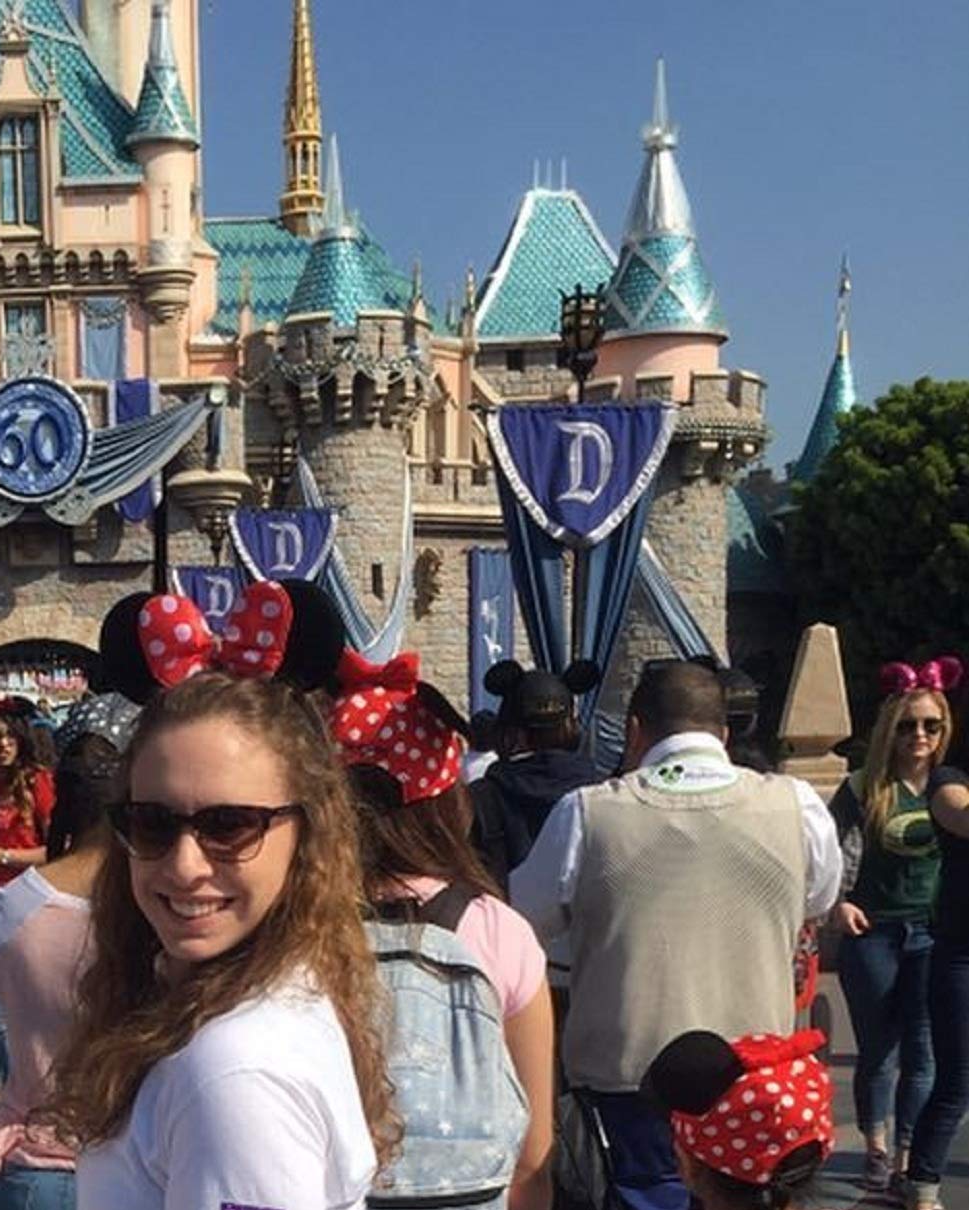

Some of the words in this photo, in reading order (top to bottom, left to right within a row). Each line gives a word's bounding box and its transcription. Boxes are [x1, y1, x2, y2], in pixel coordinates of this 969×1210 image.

[555, 421, 613, 504] D
[268, 521, 304, 571] D
[204, 575, 234, 617] D
